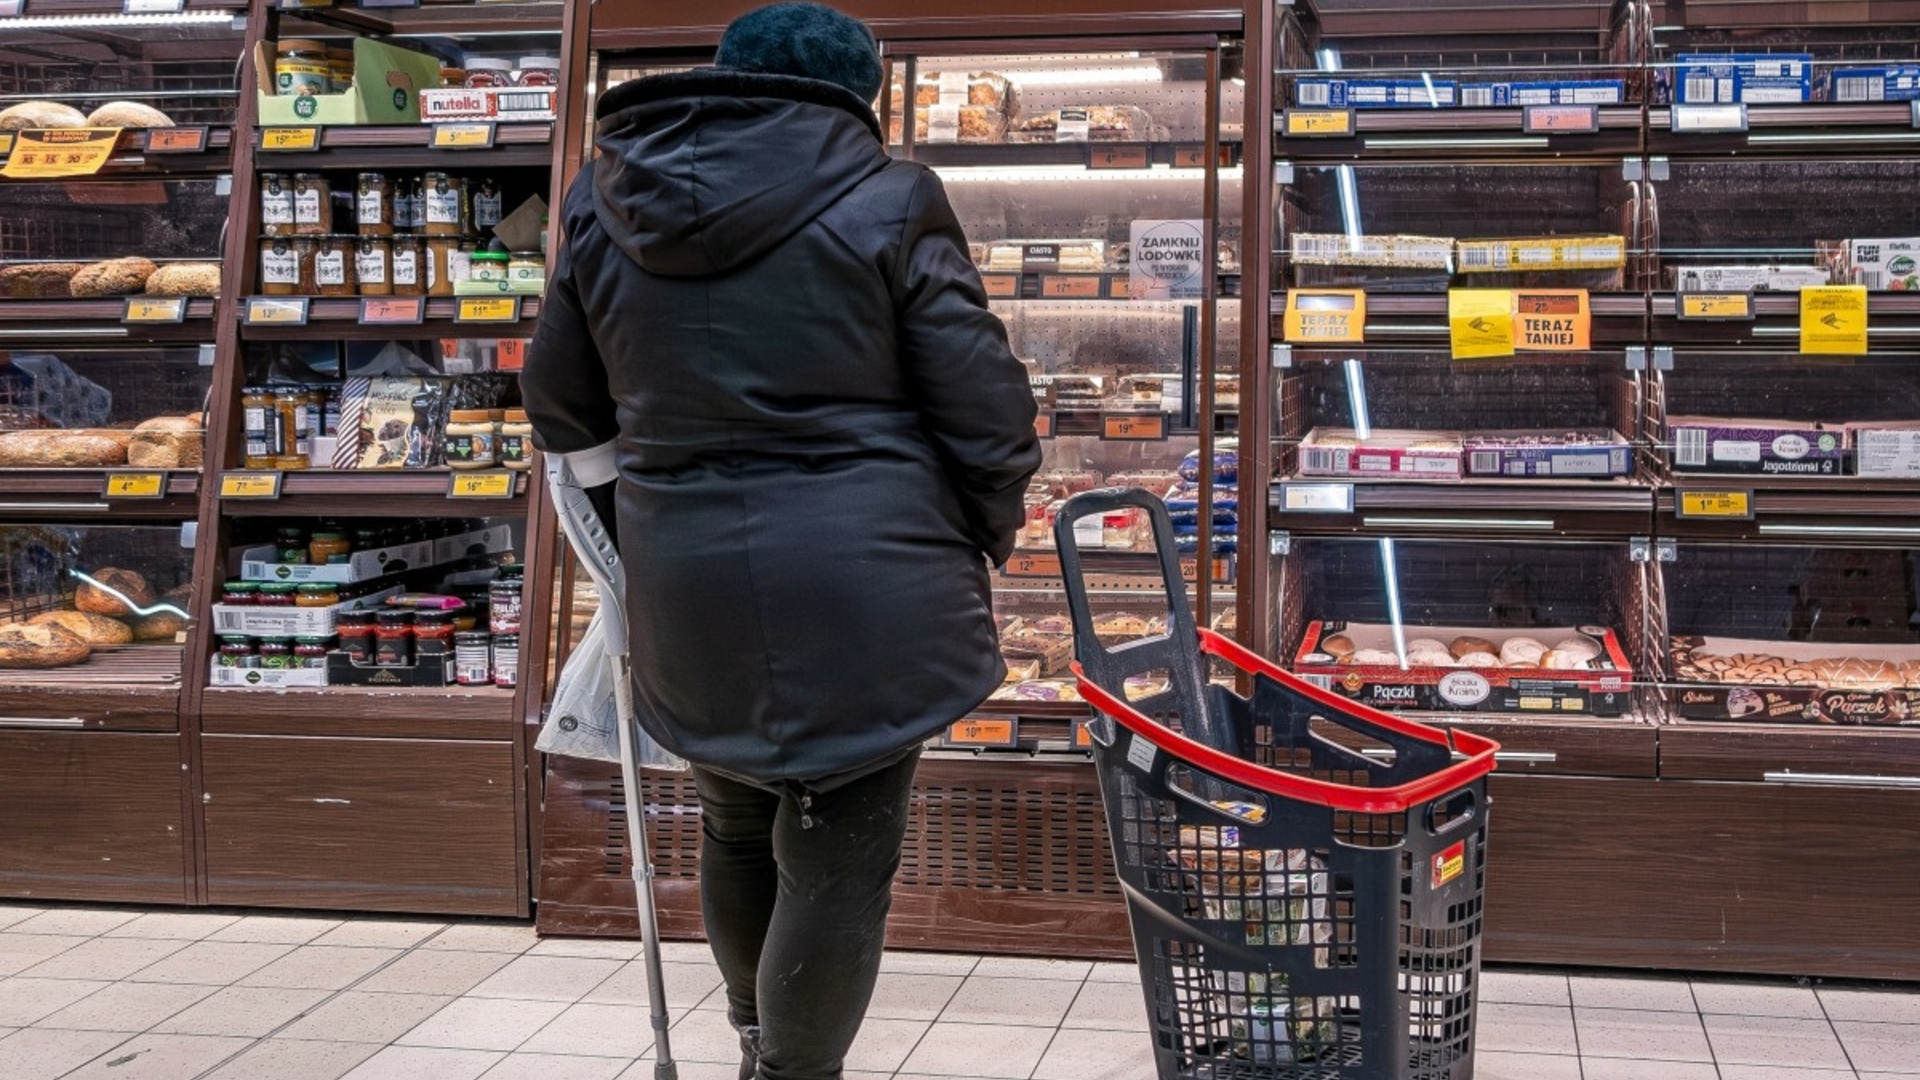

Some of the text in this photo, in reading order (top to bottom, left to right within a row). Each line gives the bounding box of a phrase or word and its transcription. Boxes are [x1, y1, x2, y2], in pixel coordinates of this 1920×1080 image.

[433, 97, 480, 111] nutella
[1142, 237, 1200, 248] ZAMKNIJ
[1300, 314, 1347, 326] TERAZ
[1525, 319, 1573, 331] TERAZ
[1300, 326, 1348, 337] TANIEJ
[1525, 333, 1573, 345] TANIEJ
[1763, 461, 1818, 474] Jagodzianki
[1373, 685, 1415, 701] Pączki
[1826, 694, 1886, 715] Pączek
